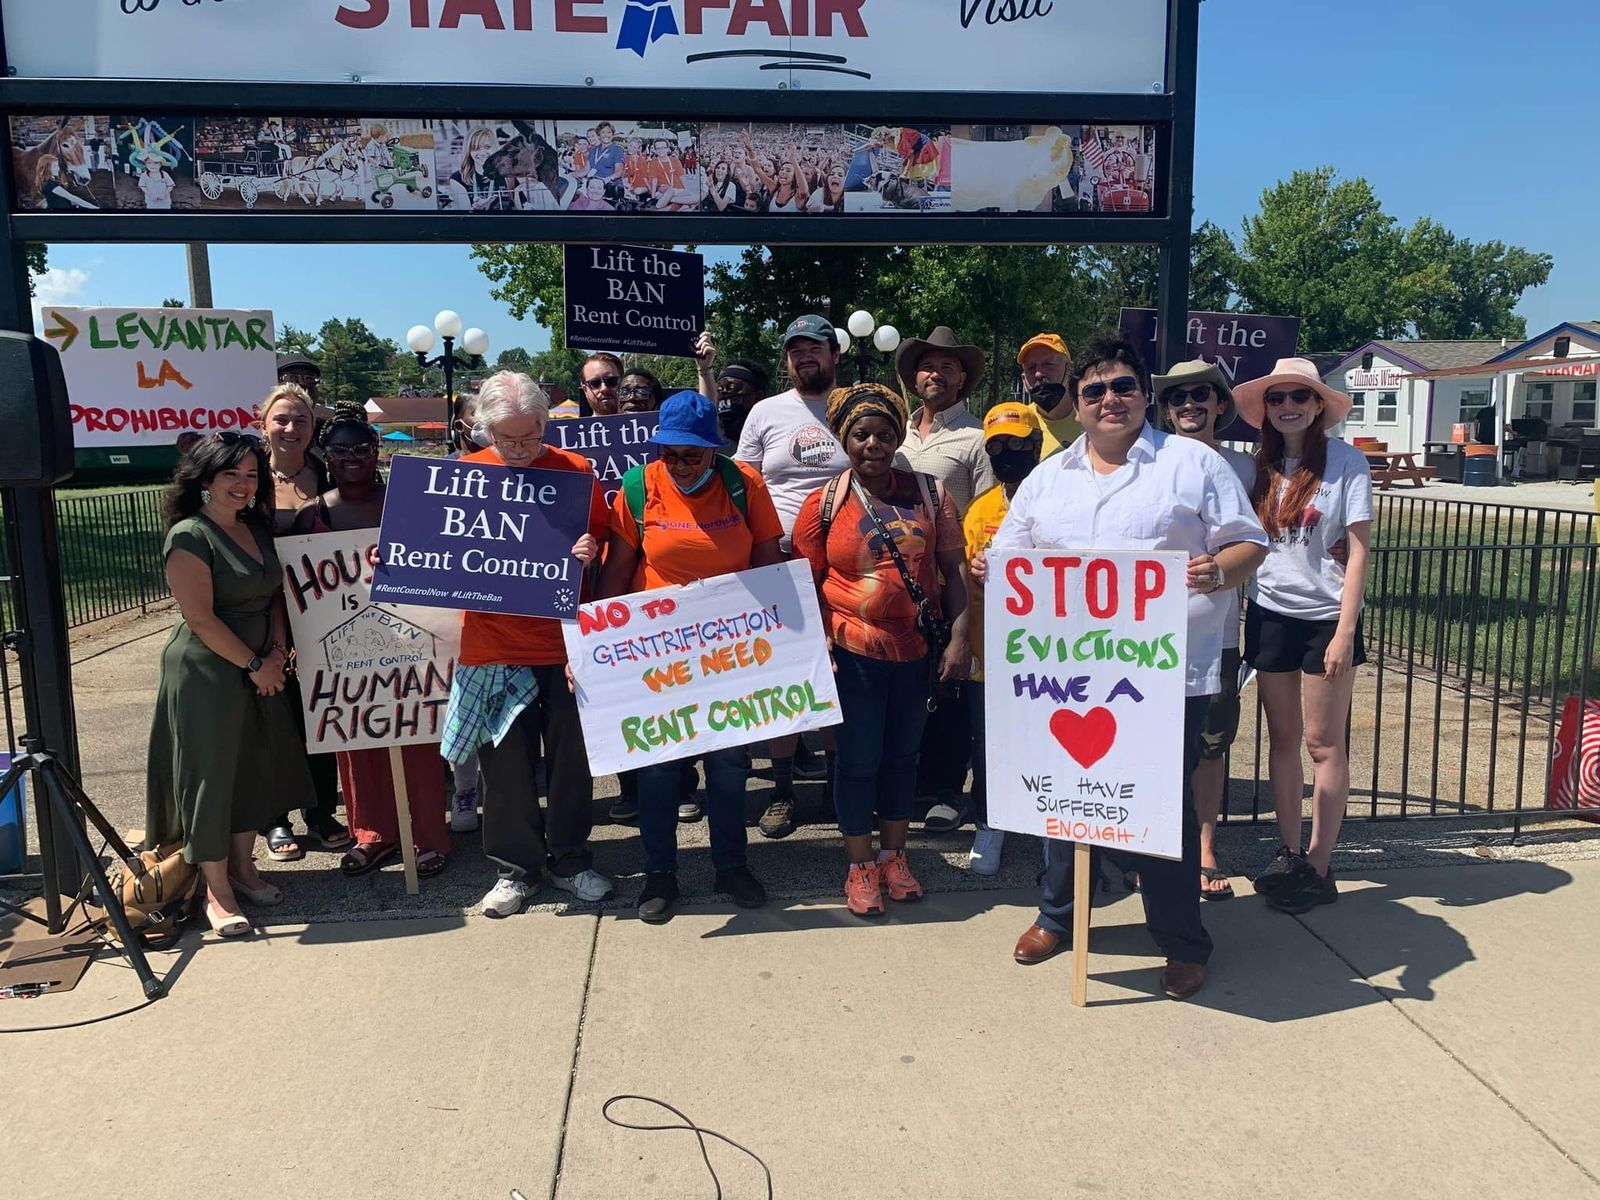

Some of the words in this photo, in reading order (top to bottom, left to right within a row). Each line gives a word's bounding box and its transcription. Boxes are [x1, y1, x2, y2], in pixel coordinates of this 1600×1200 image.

[590, 248, 636, 272] Lift
[643, 254, 681, 277] the
[607, 278, 666, 304] BAN
[89, 312, 273, 351] LEVANTAR
[573, 304, 620, 325] Rent
[625, 309, 697, 332] Control
[1217, 320, 1267, 348] the
[136, 359, 193, 389] LA
[1354, 370, 1379, 387] Illinois
[556, 421, 611, 450] Lift
[424, 465, 490, 499] Lift
[501, 474, 557, 505] the
[440, 506, 530, 543] BAN
[385, 542, 453, 571] Rent
[461, 548, 569, 582] Control
[341, 593, 359, 611] IS
[375, 583, 449, 597] #RentControlNow
[451, 591, 503, 603] #LiftTheBan
[1005, 556, 1166, 621] STOP
[330, 620, 356, 644] LIFT
[377, 613, 422, 640] BAN
[578, 601, 631, 636] NO
[641, 598, 677, 619] TO
[592, 604, 783, 667] GENTRIFICATION
[346, 659, 374, 670] RENT
[642, 659, 693, 693] WE
[700, 637, 772, 677] NEED
[309, 656, 455, 712] HUMAN
[1012, 673, 1091, 703] HAVE
[1105, 677, 1144, 703] A
[316, 699, 449, 744] RIGHT
[621, 703, 699, 753] RENT
[707, 680, 835, 732] CONTROL
[1021, 774, 1052, 793] WE
[1077, 777, 1136, 799] HAVE
[1036, 796, 1129, 825] SUFFERED
